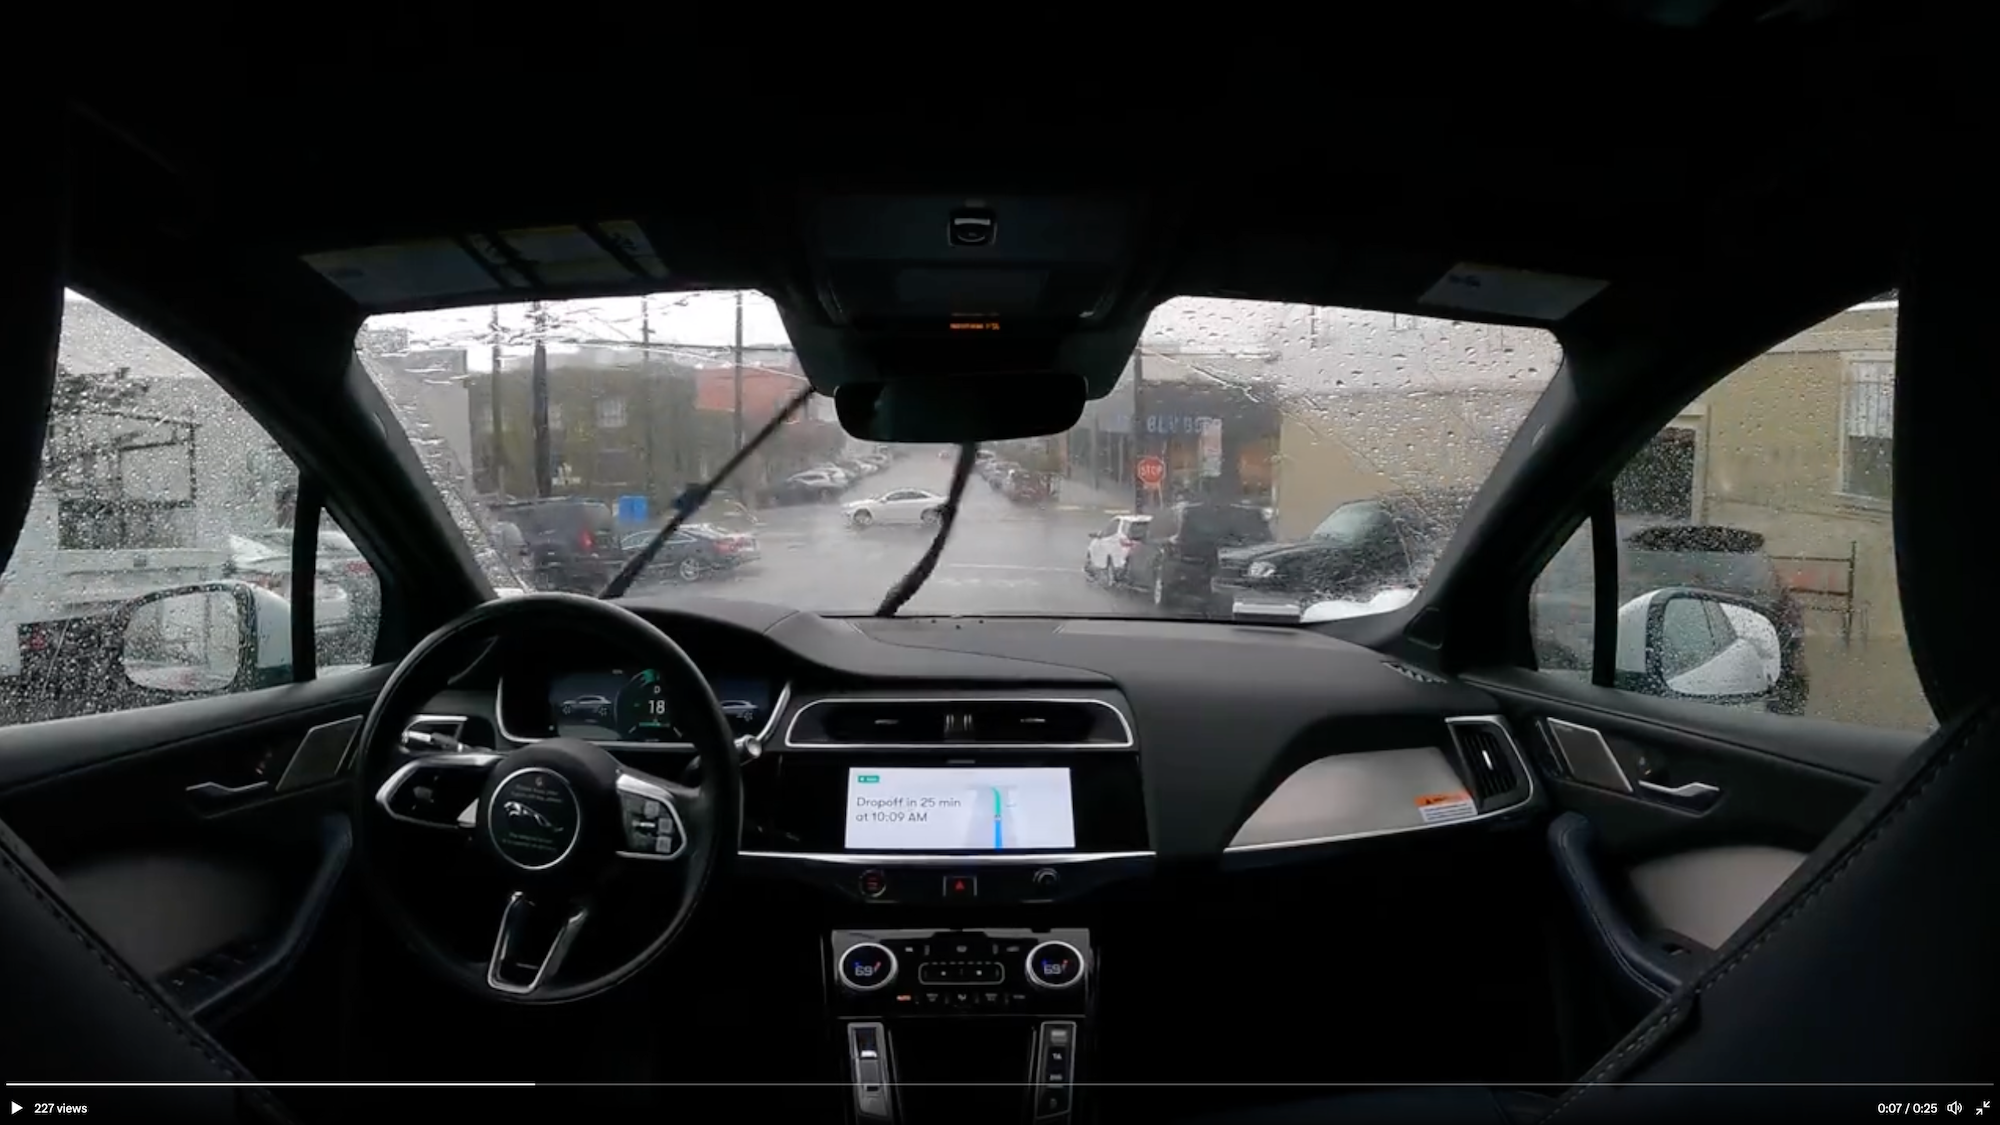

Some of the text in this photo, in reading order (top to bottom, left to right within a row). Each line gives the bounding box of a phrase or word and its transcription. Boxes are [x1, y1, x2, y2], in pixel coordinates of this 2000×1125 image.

[1140, 463, 1163, 476] STOP
[648, 699, 666, 714] 18
[856, 797, 962, 809] Dropoff in 25 min
[855, 811, 928, 822] at 10:09 AM
[855, 965, 873, 977] 69
[1043, 963, 1062, 975] 69
